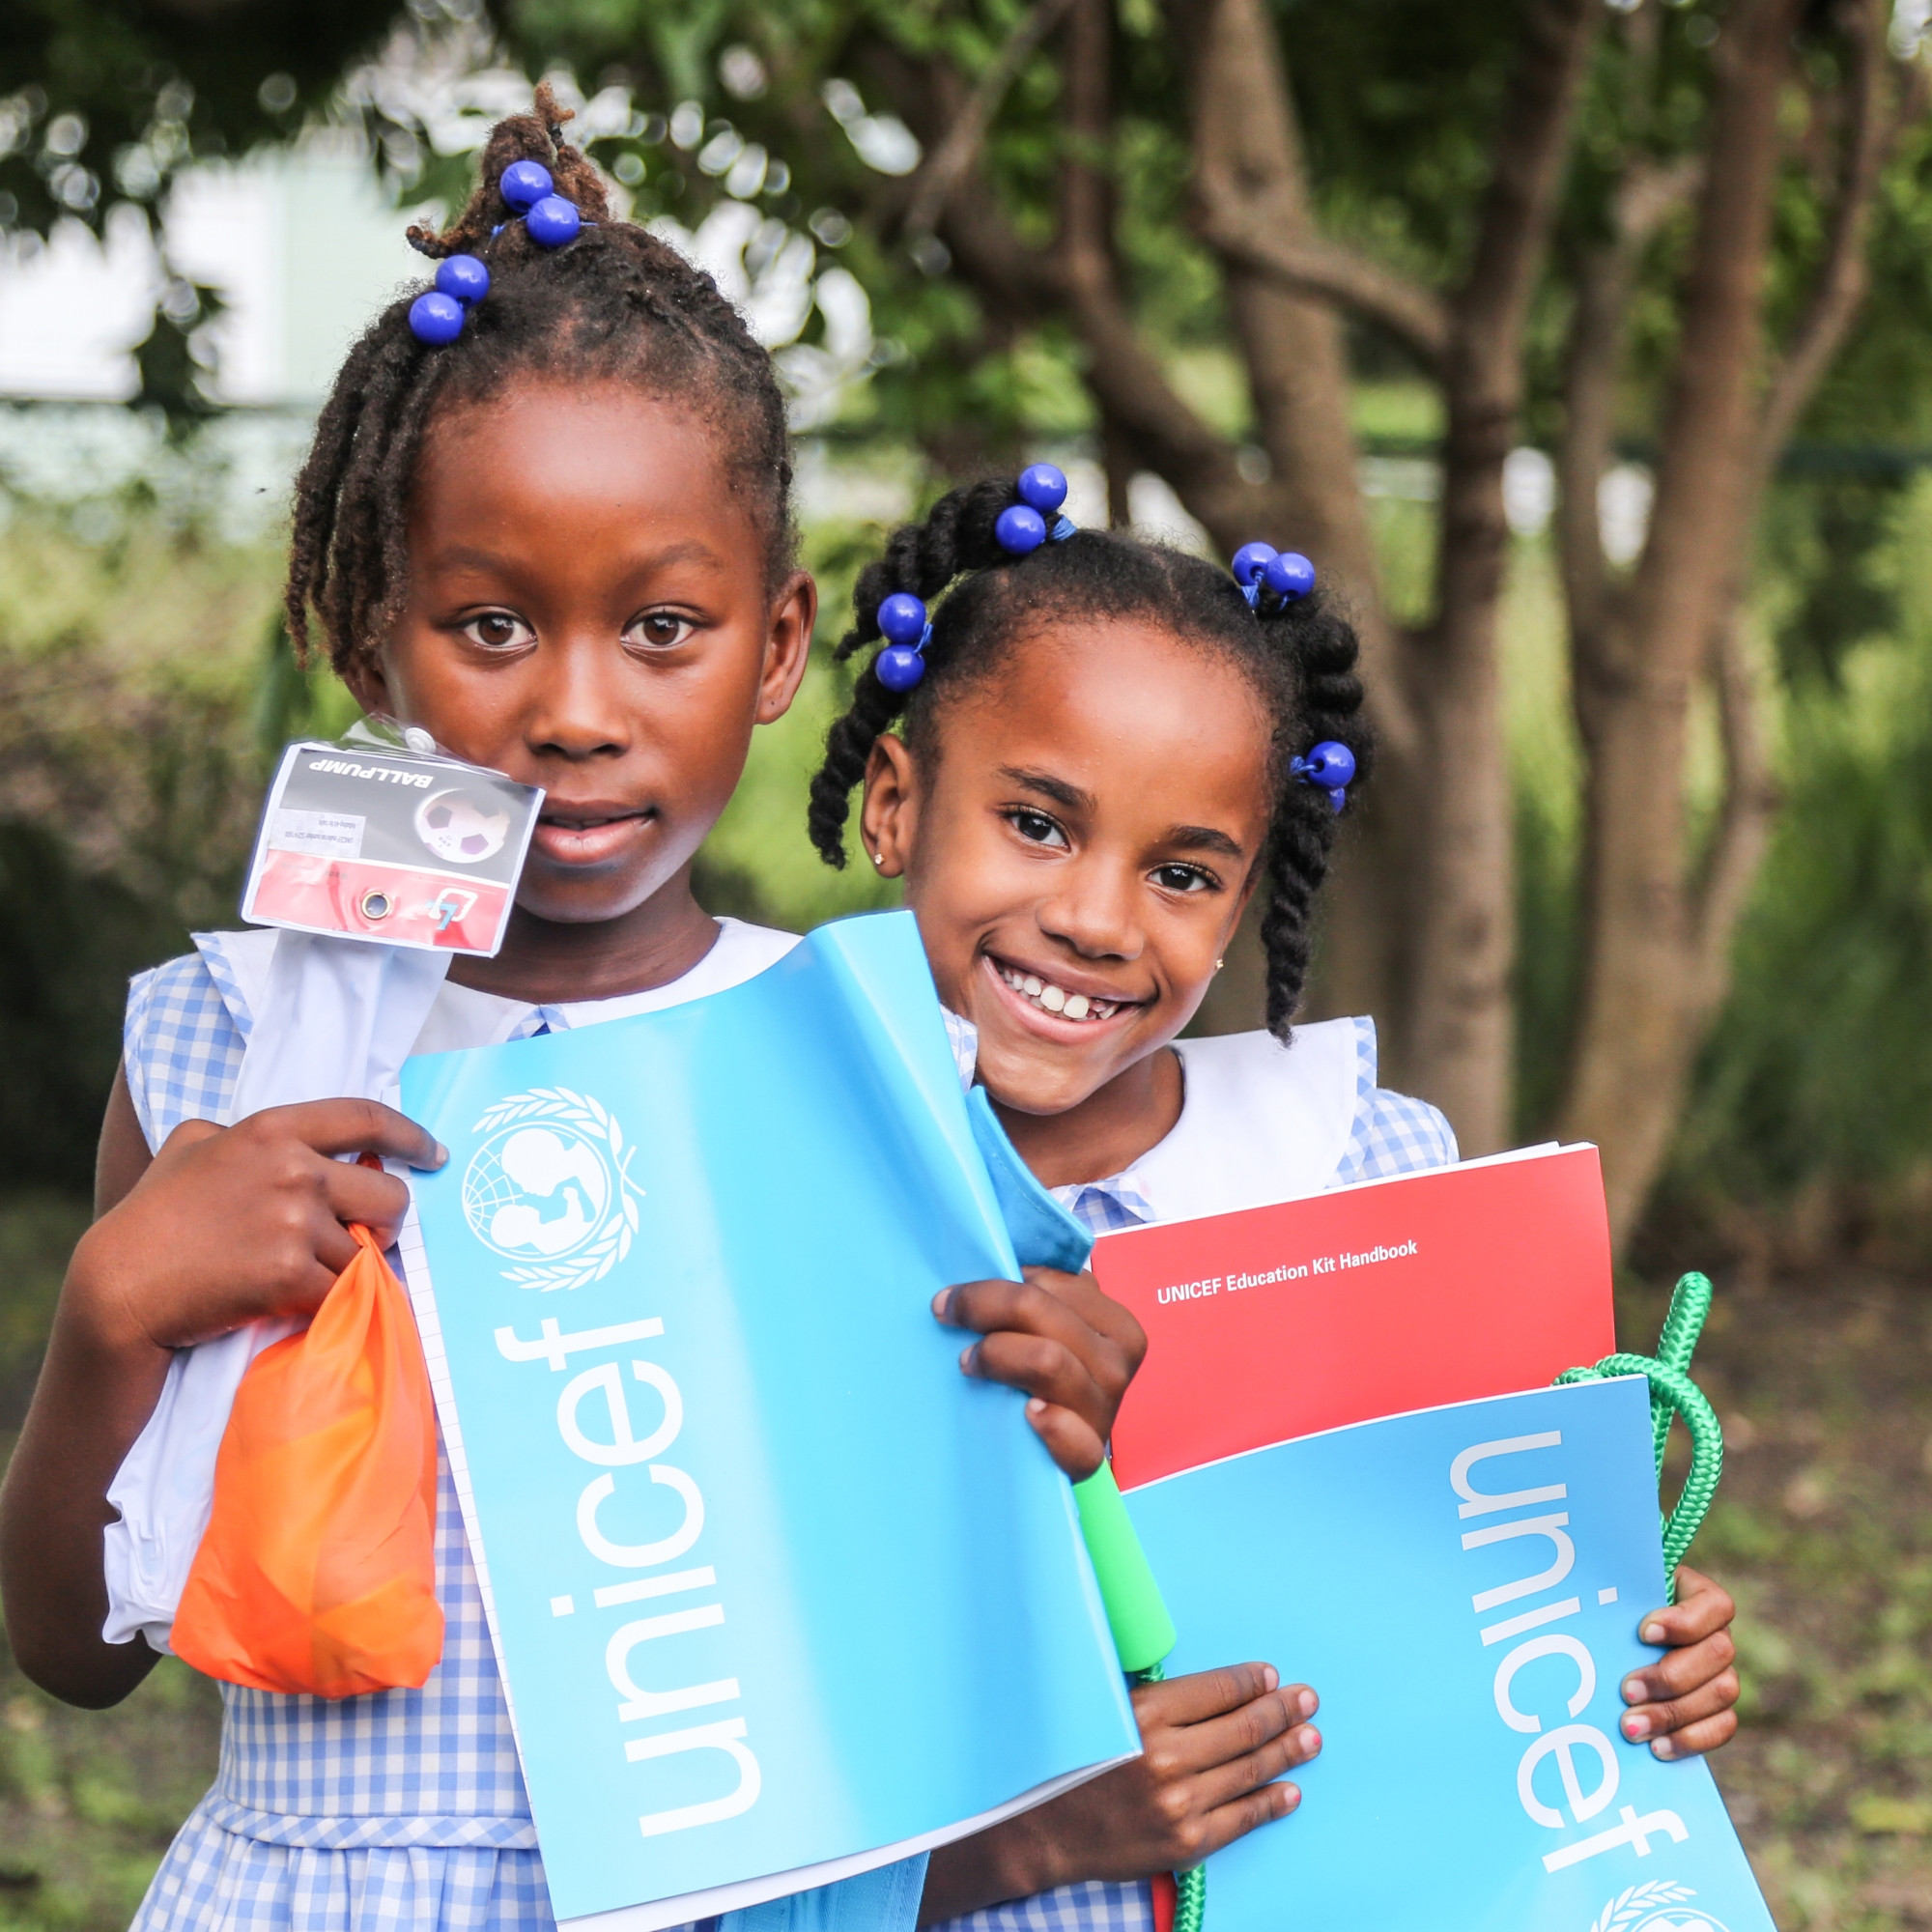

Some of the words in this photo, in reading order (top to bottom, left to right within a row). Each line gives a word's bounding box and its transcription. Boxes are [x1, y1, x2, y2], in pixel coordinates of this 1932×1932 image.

[309, 758, 434, 788] BALLPUMP
[1157, 1277, 1222, 1304] UNICEF
[1226, 1264, 1308, 1292] Education
[1313, 1257, 1336, 1274] Kit
[1339, 1239, 1417, 1269] Handbook
[494, 1317, 762, 1837] unicef
[1449, 1431, 1690, 1873] unicef
